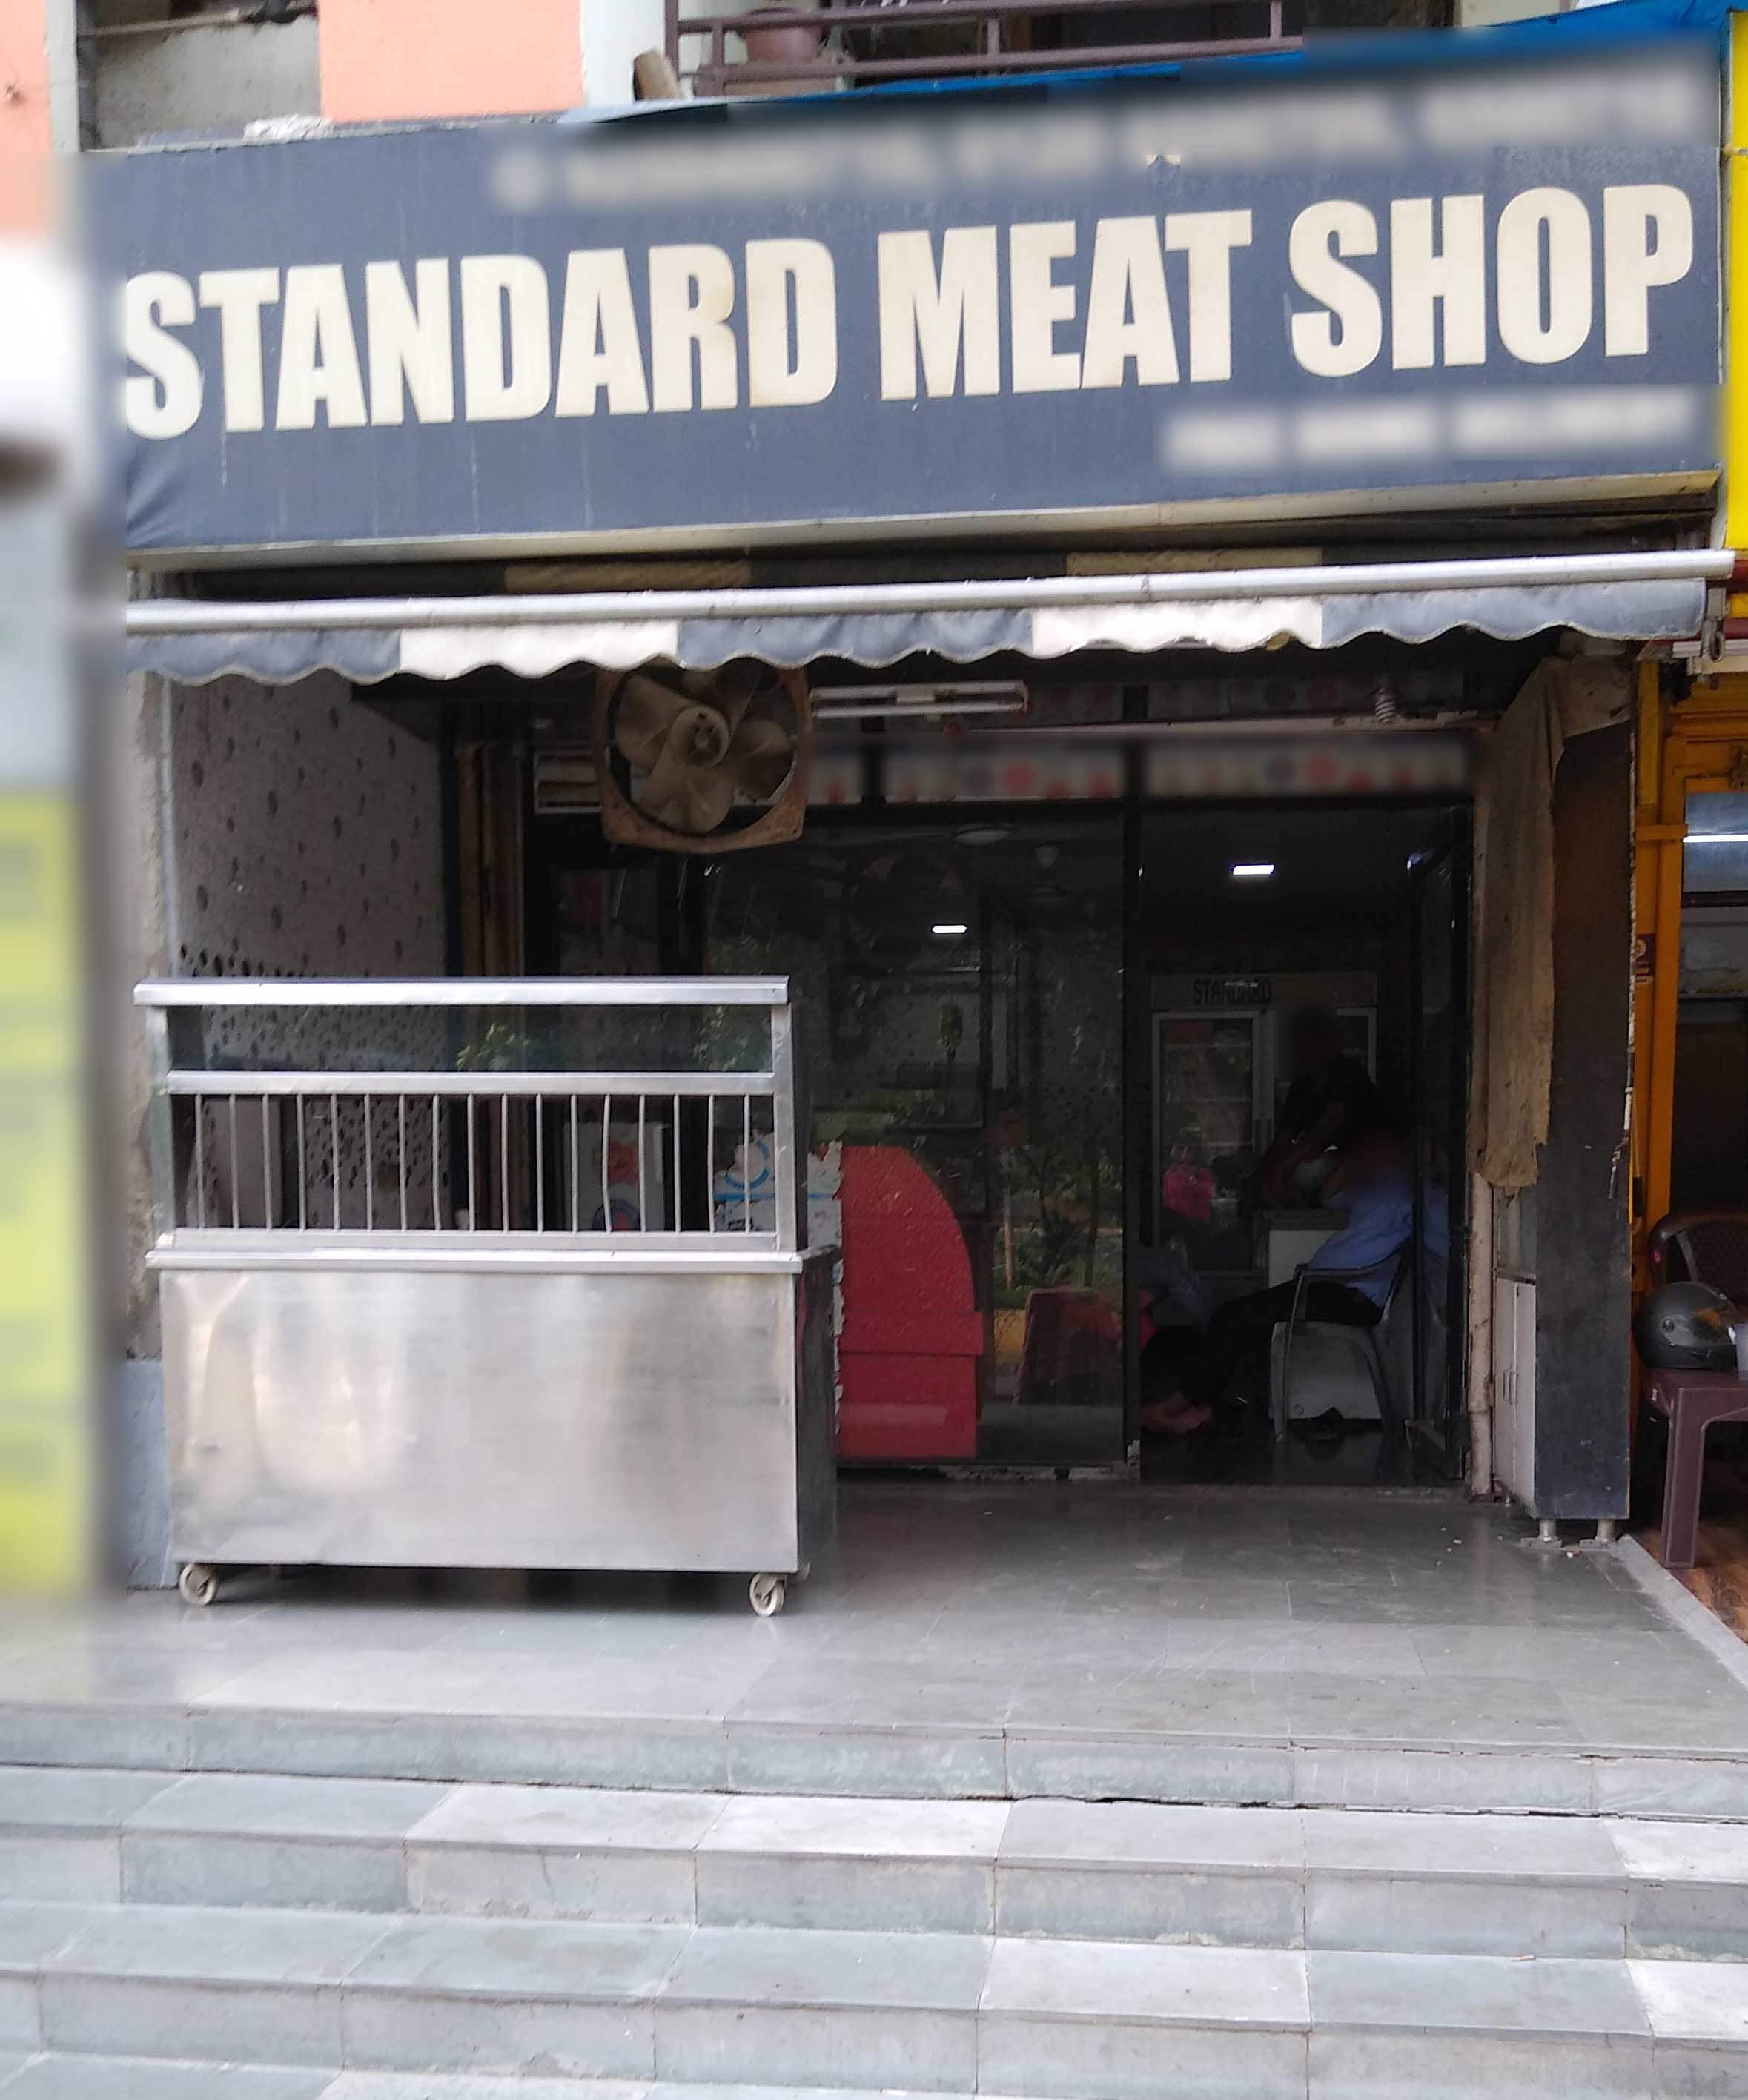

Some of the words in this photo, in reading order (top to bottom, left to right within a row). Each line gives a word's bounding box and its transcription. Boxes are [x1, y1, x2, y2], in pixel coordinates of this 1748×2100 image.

[125, 238, 838, 440] STANDARD
[878, 208, 1253, 401] MEAT
[1288, 184, 1693, 379] SHOP
